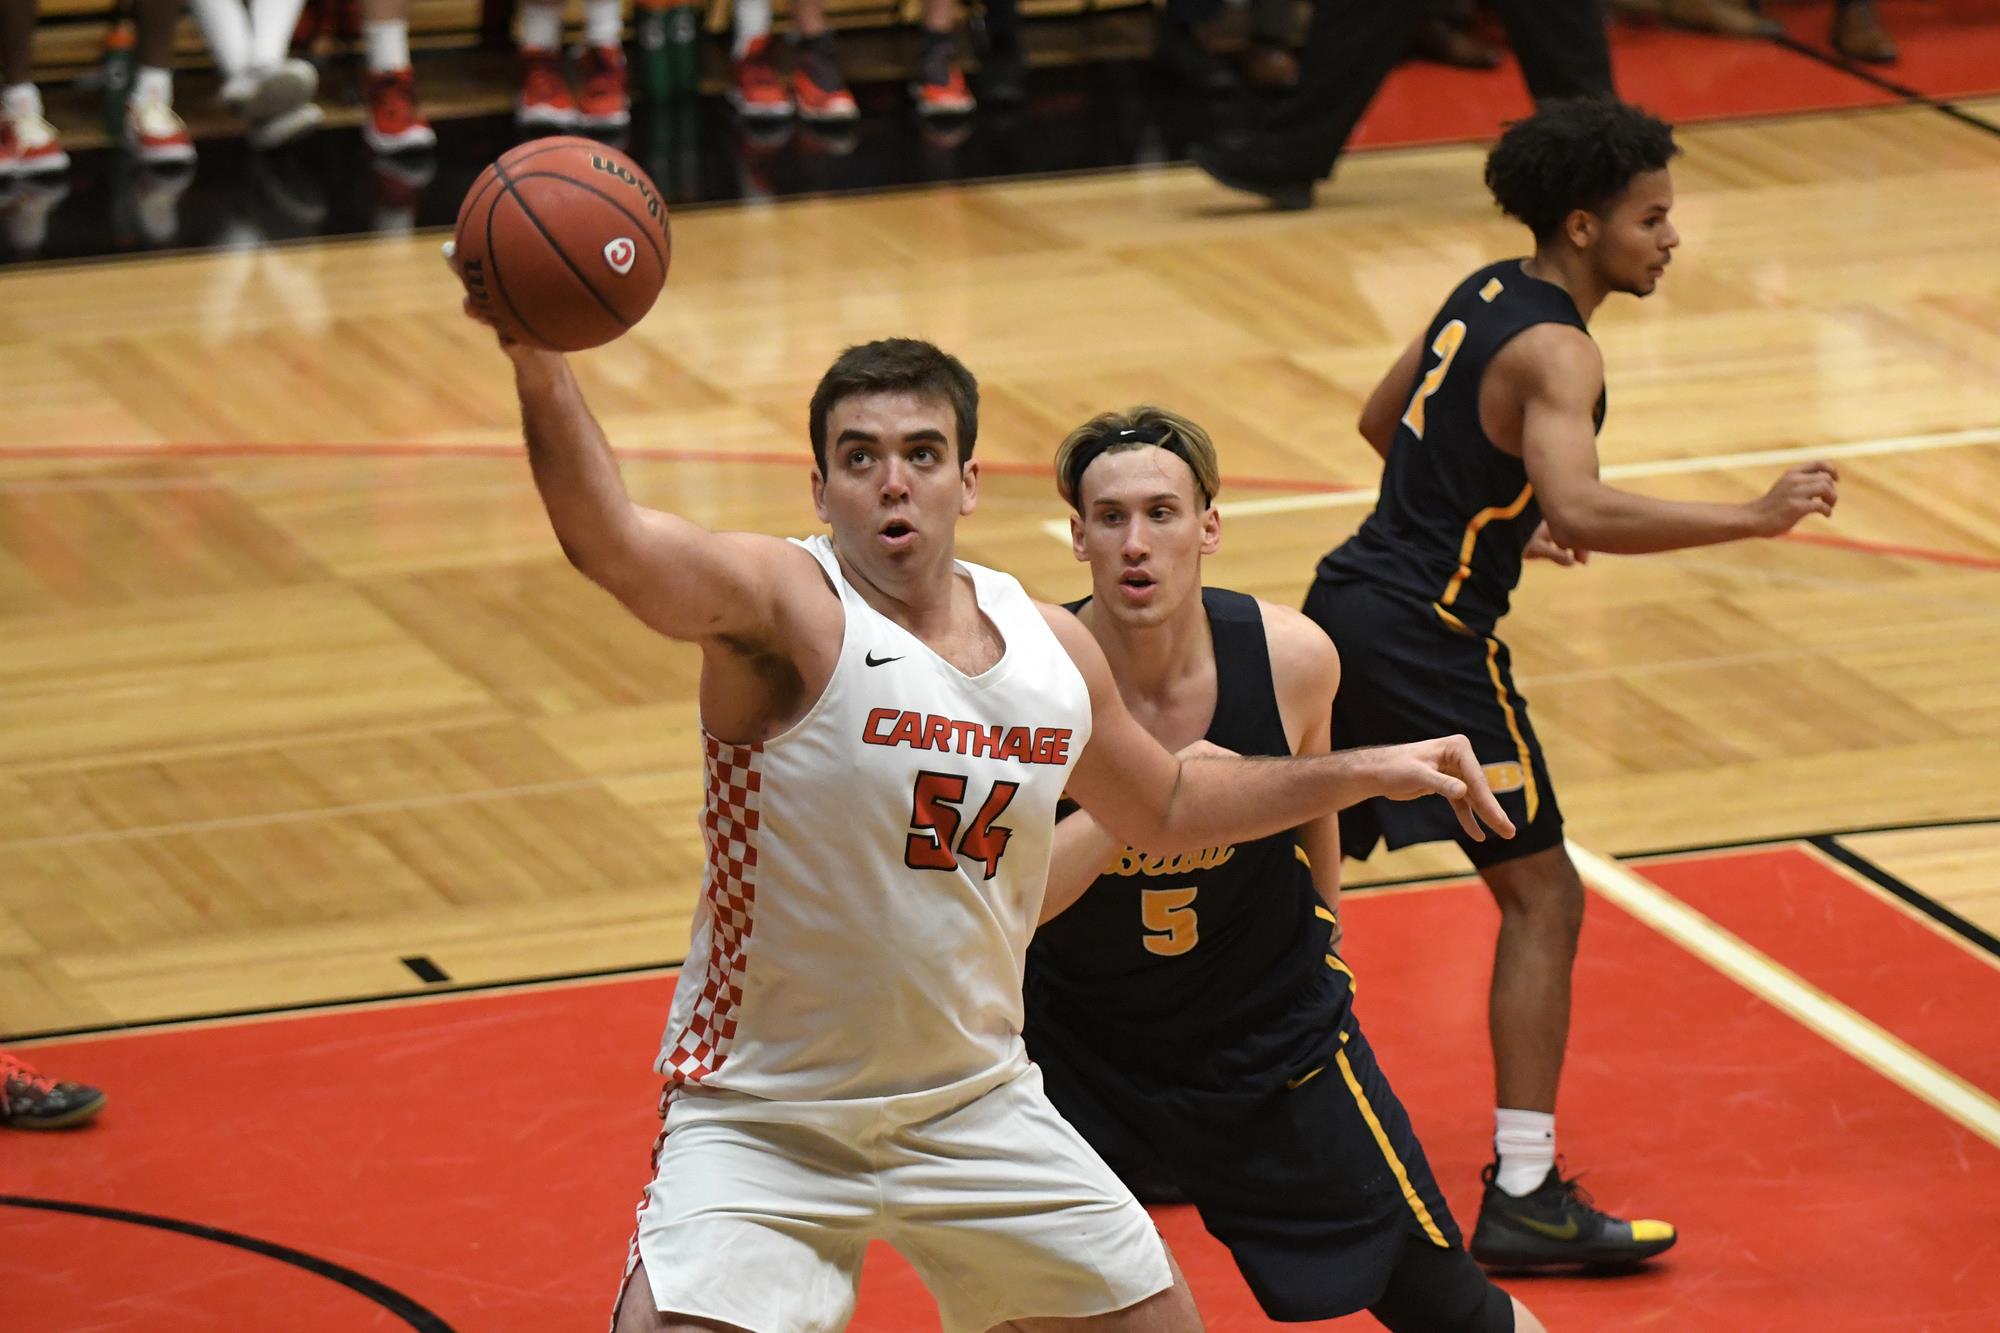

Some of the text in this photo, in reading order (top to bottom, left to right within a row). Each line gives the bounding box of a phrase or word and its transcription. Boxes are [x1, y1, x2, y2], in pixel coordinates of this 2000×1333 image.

[1401, 319, 1467, 440] 2
[862, 707, 1073, 765] CARTHAGE
[904, 769, 1020, 881] 54
[1141, 886, 1199, 956] 5
